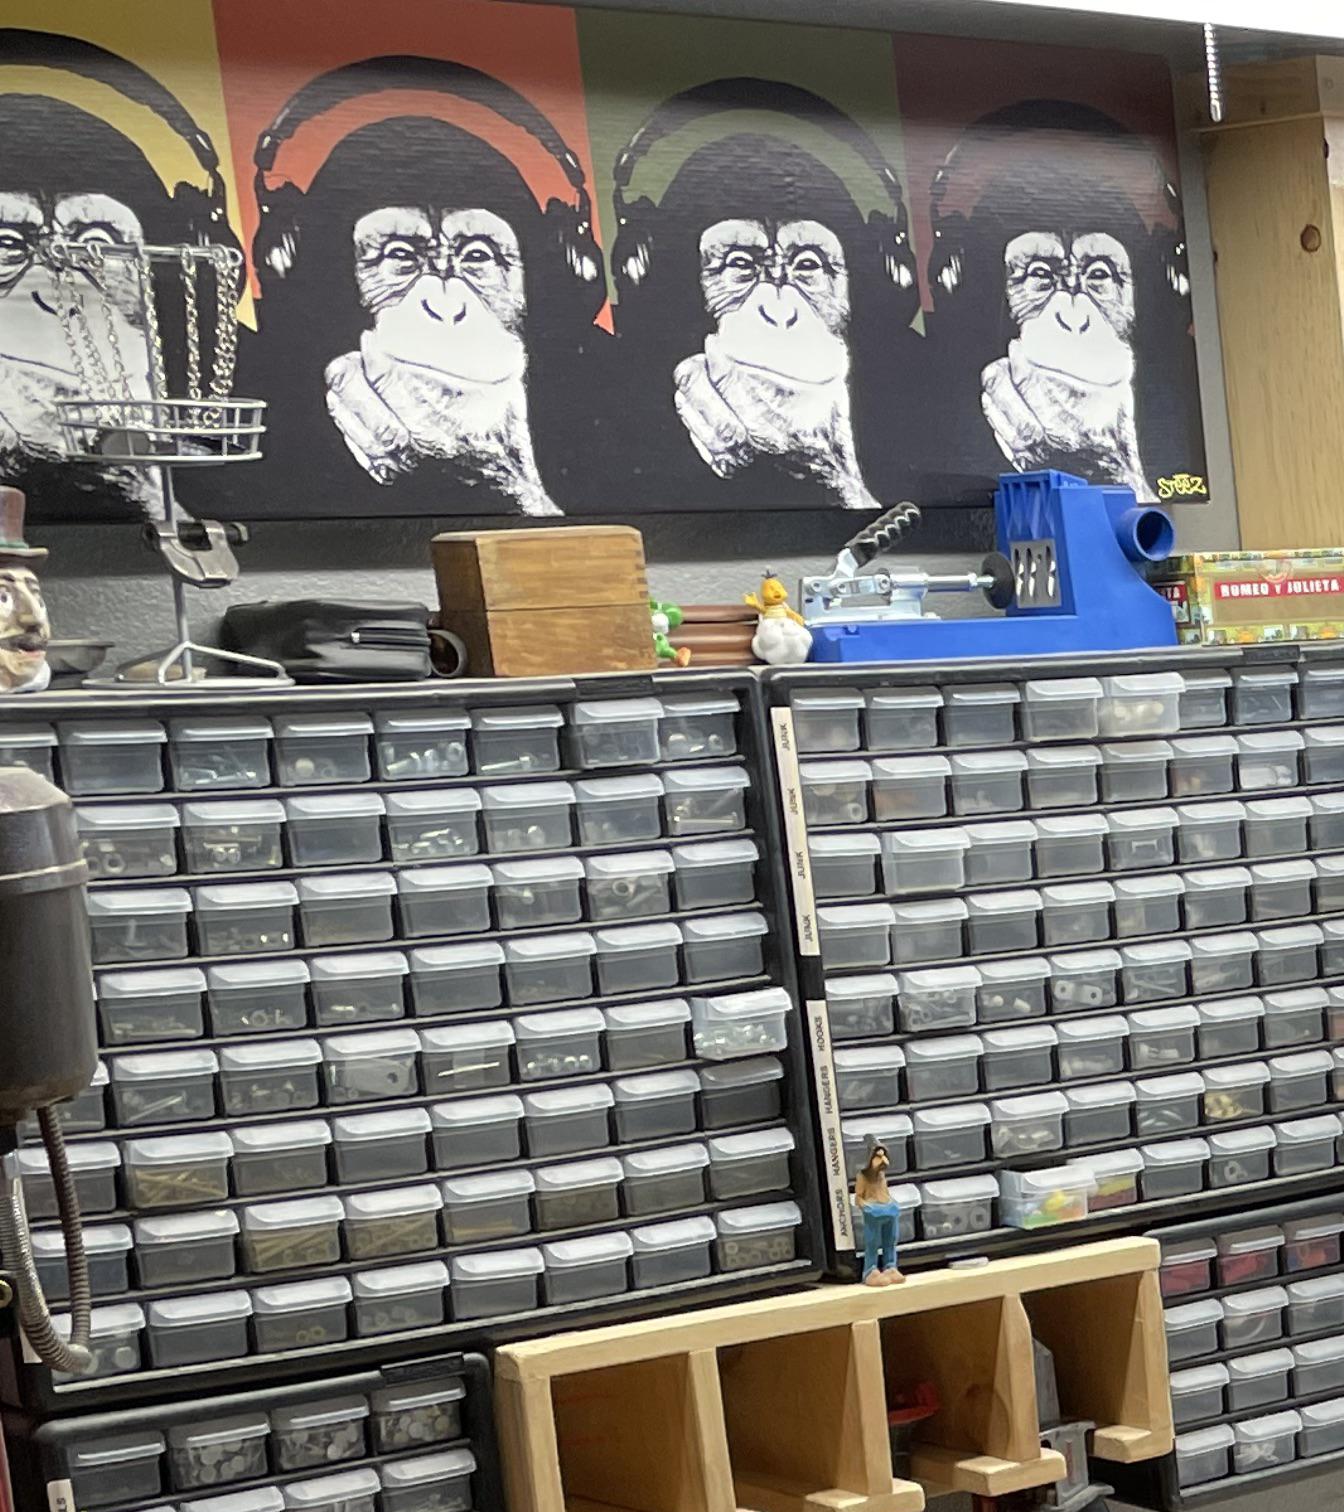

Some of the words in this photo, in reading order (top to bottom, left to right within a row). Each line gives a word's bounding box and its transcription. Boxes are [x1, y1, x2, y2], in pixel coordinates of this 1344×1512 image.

[1220, 582, 1269, 597] ROMEO
[1275, 584, 1282, 595] Y
[1287, 579, 1340, 595] JULIETA
[783, 723, 791, 752] JUNK
[798, 851, 807, 880] JUNK
[814, 1016, 824, 1052] HOOKS
[821, 1065, 834, 1115] HANGERS
[827, 1127, 840, 1177] HANGERS
[835, 1188, 848, 1237] ANCHORS
